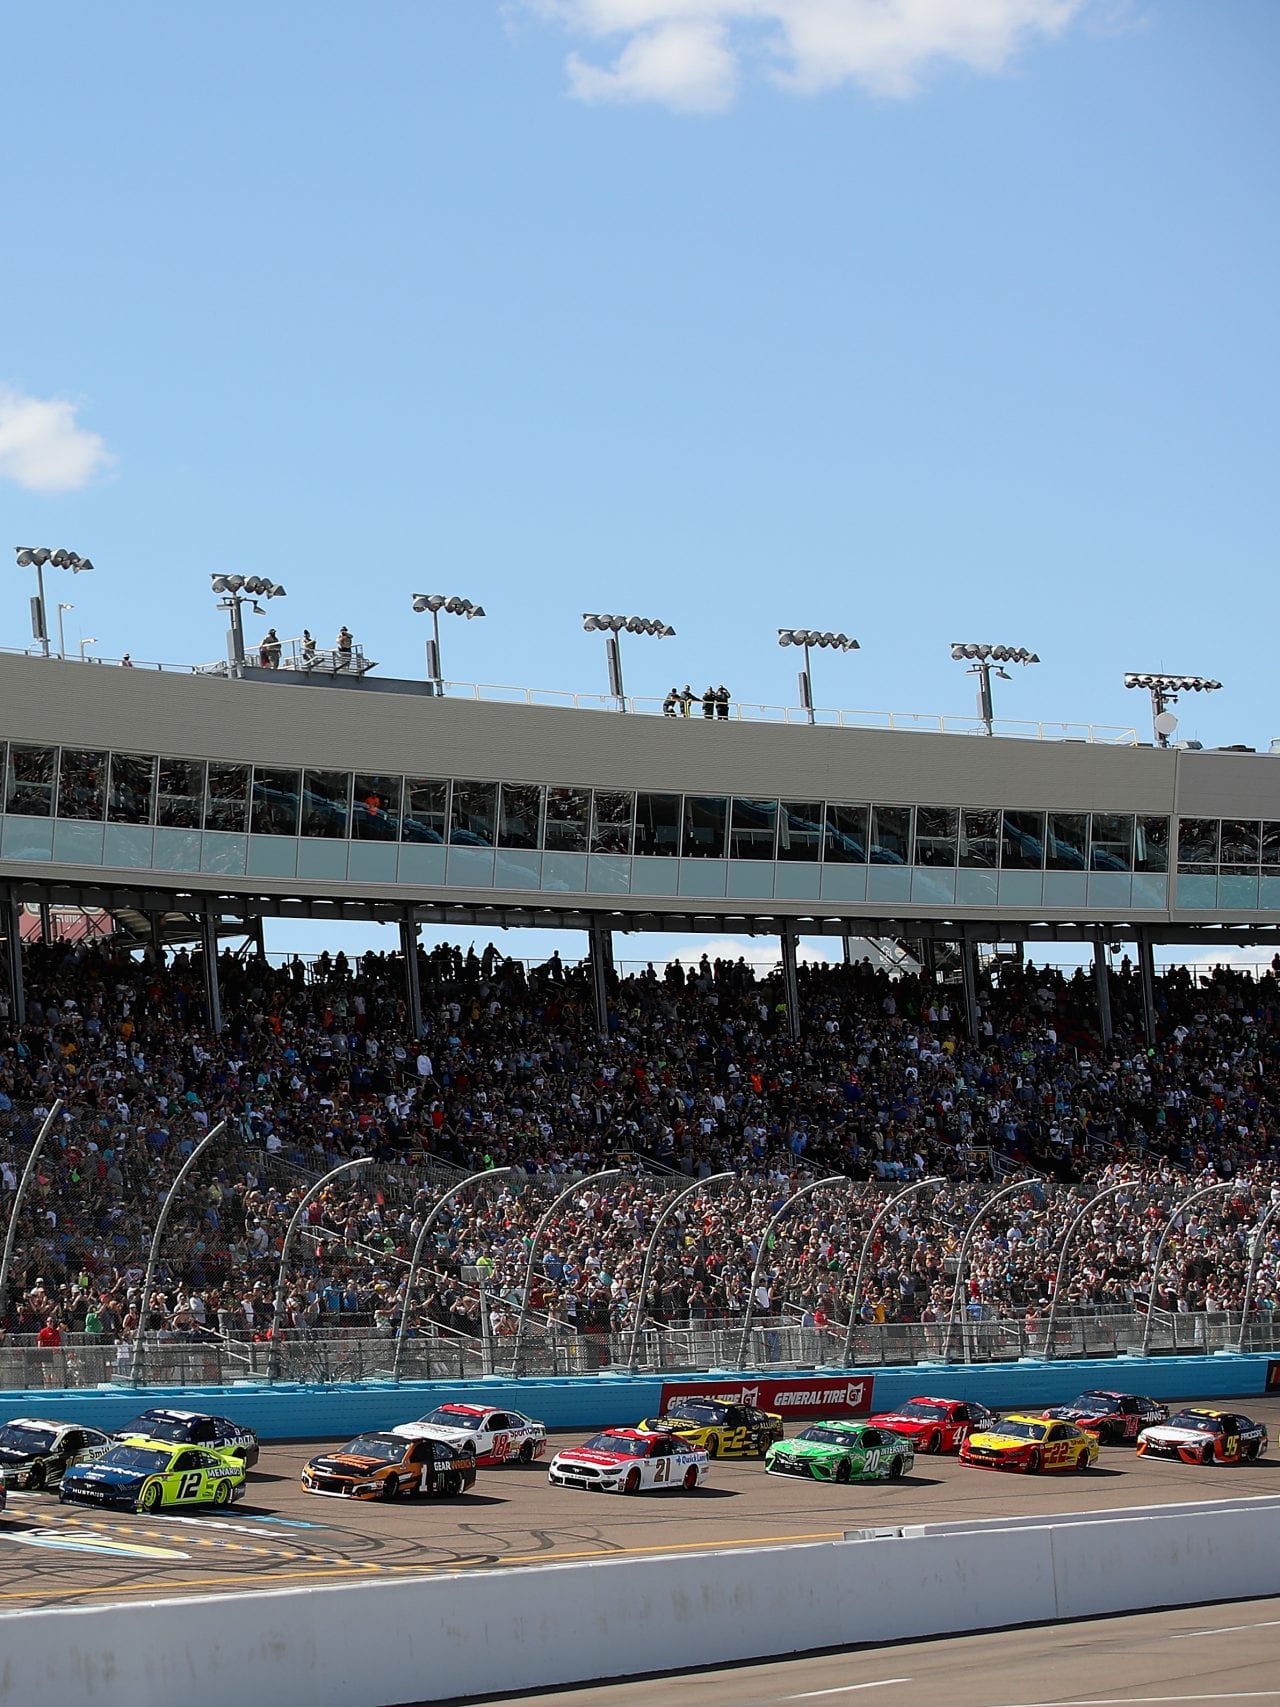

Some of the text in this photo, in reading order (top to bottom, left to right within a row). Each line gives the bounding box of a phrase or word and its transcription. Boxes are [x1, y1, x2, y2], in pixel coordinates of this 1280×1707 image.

[773, 1389, 847, 1406] GENERAL TIRE
[224, 1434, 254, 1447] AXALTA
[490, 1433, 510, 1458] 18
[731, 1426, 747, 1449] 2
[952, 1426, 968, 1445] 41
[1224, 1435, 1240, 1457] 95
[863, 1450, 880, 1473] 20
[1051, 1441, 1070, 1462] 22
[419, 1464, 428, 1492] 1
[653, 1458, 670, 1482] 21
[176, 1472, 202, 1499] 12
